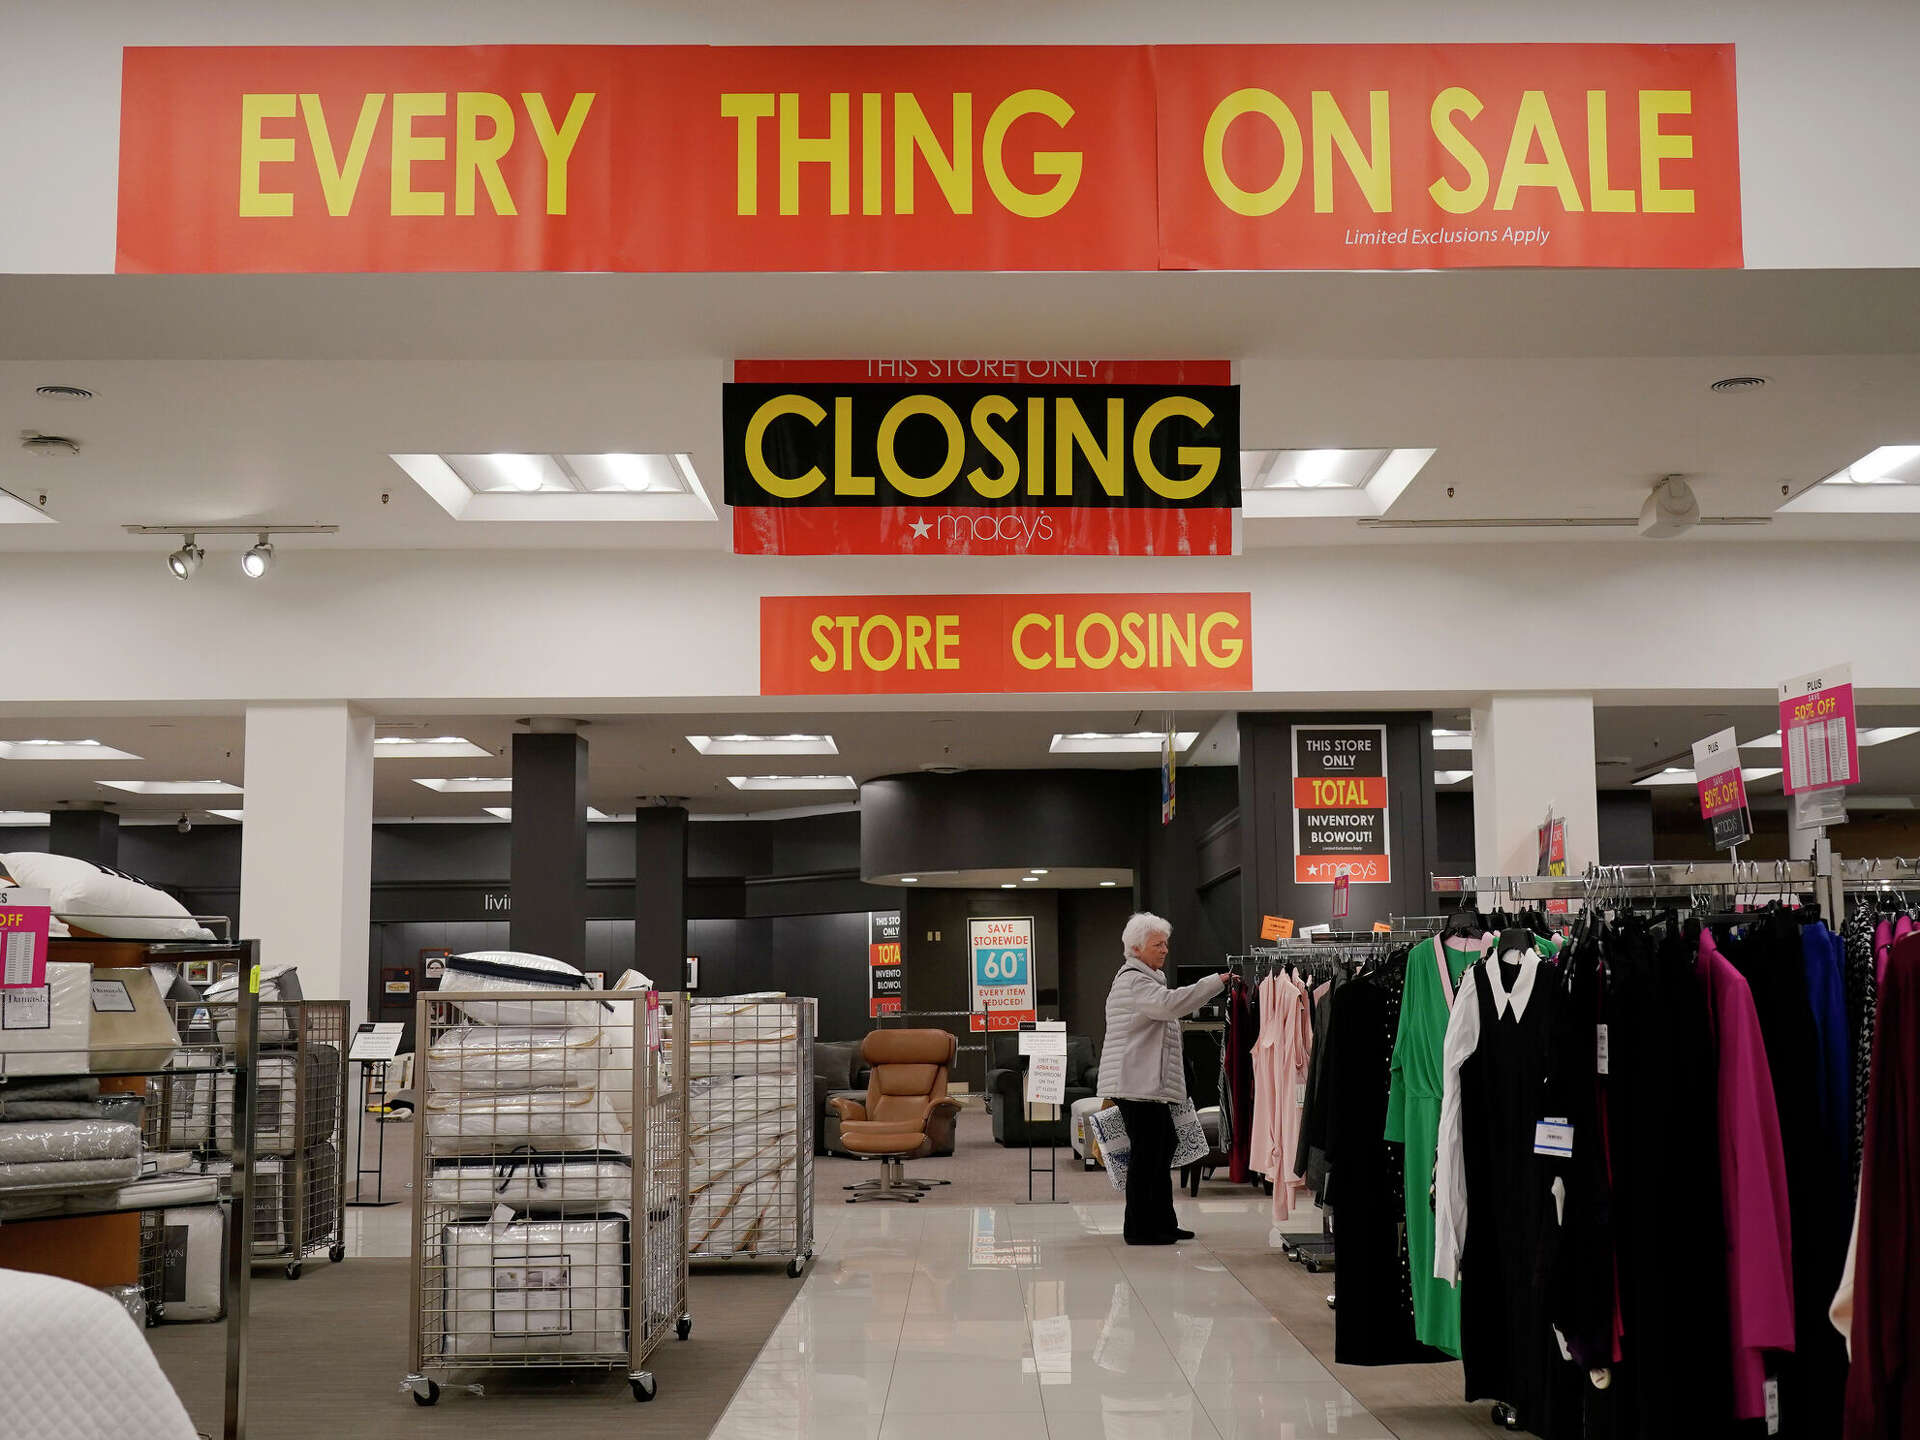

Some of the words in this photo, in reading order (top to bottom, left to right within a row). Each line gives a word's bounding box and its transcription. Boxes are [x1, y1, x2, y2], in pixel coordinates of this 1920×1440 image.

[239, 92, 596, 218] EVERY
[721, 89, 1083, 218] THING
[1203, 88, 1392, 216] ON
[1428, 86, 1696, 214] SALE
[1345, 228, 1408, 246] Limited
[1411, 227, 1498, 246] Exclusions
[1501, 226, 1550, 246] Apply
[867, 359, 918, 377] THIS
[928, 359, 1016, 377] STORE
[1027, 359, 1100, 377] ONLY
[744, 394, 1221, 499] CLOSING
[937, 510, 1053, 548] macy's
[809, 614, 960, 672] STORE
[1011, 611, 1244, 670] CLOSING
[1807, 679, 1822, 691] PLUS
[1794, 703, 1814, 720] 50%
[1817, 697, 1836, 716] OFF
[1306, 740, 1331, 751] THIS
[1334, 740, 1372, 751] STORE
[1707, 742, 1720, 754] PLUS
[1322, 755, 1356, 766] ONLY
[1312, 780, 1368, 805] TOTAL
[1704, 786, 1721, 809] 50%
[1722, 781, 1738, 802] OFF
[1307, 814, 1375, 826] INVENTORY
[1311, 831, 1372, 843] BLOWOUT!
[0, 892, 7, 904] S
[876, 917, 887, 925] THIS
[882, 927, 900, 936] ONLY
[987, 924, 1014, 933] SAVE
[973, 936, 1028, 946] STOREWIDE
[982, 998, 1023, 1007] REDUCED!
